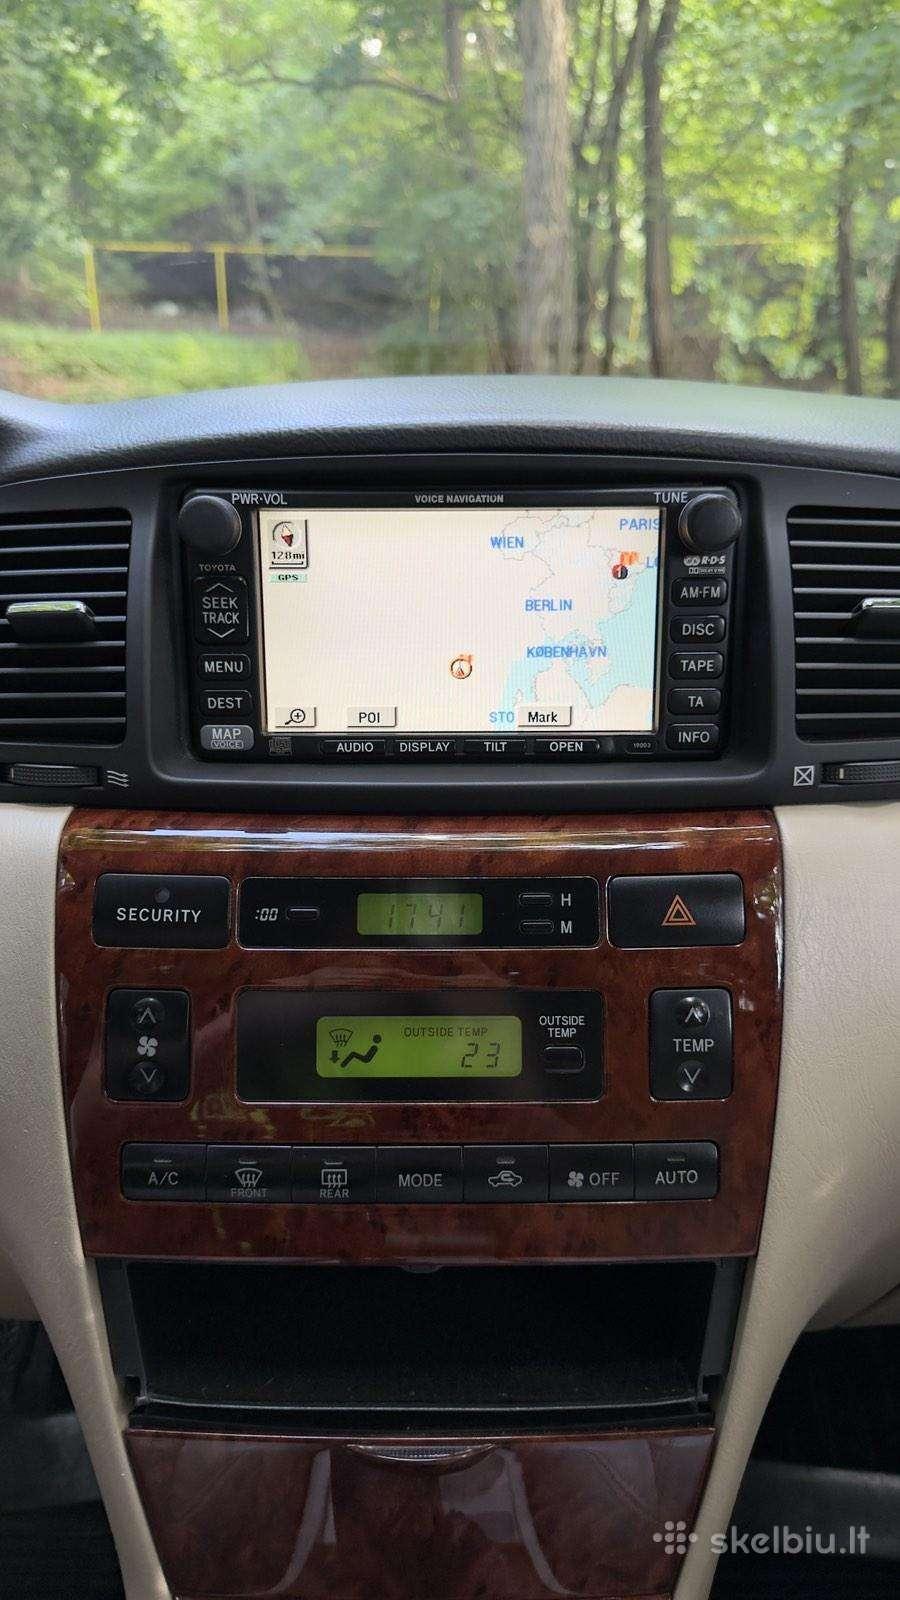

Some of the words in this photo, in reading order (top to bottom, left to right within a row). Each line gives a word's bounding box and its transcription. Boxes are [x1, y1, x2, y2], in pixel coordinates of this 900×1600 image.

[414, 494, 444, 504] VOICE
[446, 494, 504, 504] NAVIGATION
[653, 491, 688, 504] TUNE
[619, 518, 660, 531] PARIS
[490, 535, 525, 549] WIEN
[199, 563, 236, 572] TOYOTA
[202, 596, 239, 610] SEEK
[524, 598, 573, 613] BERLIN
[202, 611, 240, 625] TRACK
[682, 622, 715, 637] DISC
[526, 645, 607, 659] KØBENHAVN
[204, 660, 244, 674] MENU
[680, 659, 714, 673] TAPE
[207, 696, 243, 710] DEST
[687, 695, 705, 709] TA
[358, 711, 381, 725] POI
[527, 710, 558, 725] Mark
[211, 727, 242, 740] MAP
[677, 730, 710, 745] INFO
[336, 740, 374, 754] AUDIO
[399, 740, 450, 754] DISPLAY
[483, 740, 508, 753] TILT
[549, 740, 584, 753] OPEN
[560, 894, 572, 908] H
[115, 907, 202, 924] SECURITY
[560, 921, 573, 935] M
[538, 1015, 585, 1027] OUTSIDE
[403, 1026, 453, 1038] OUTSIDE
[456, 1026, 489, 1038] TEMP
[547, 1027, 577, 1039] TEMP
[672, 1038, 715, 1054] TEMP
[460, 1041, 502, 1069] 23
[148, 1170, 179, 1187] A/C
[397, 1173, 443, 1189] MODE
[589, 1172, 620, 1187] OFF
[654, 1169, 699, 1186] AUTO
[230, 1187, 268, 1199] FRONT
[319, 1188, 350, 1200] REAR
